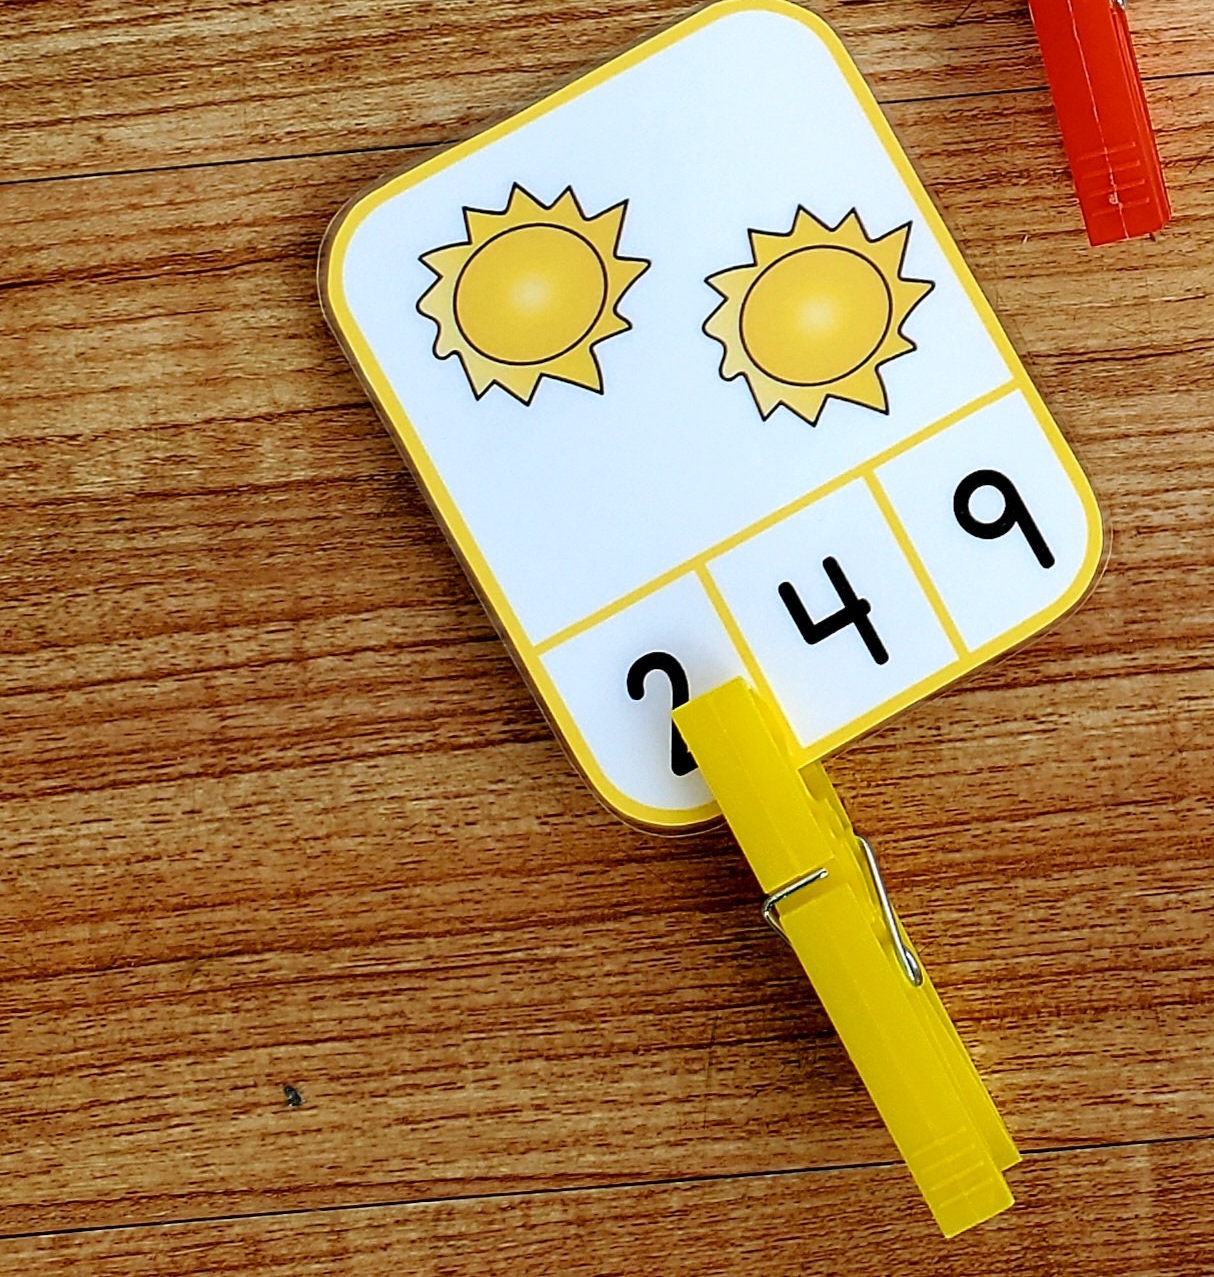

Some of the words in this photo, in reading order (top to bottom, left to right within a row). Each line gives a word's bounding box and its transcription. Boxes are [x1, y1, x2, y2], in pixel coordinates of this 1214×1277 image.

[626, 651, 700, 777] 2
[778, 556, 889, 666] 4
[953, 469, 1055, 569] 9
